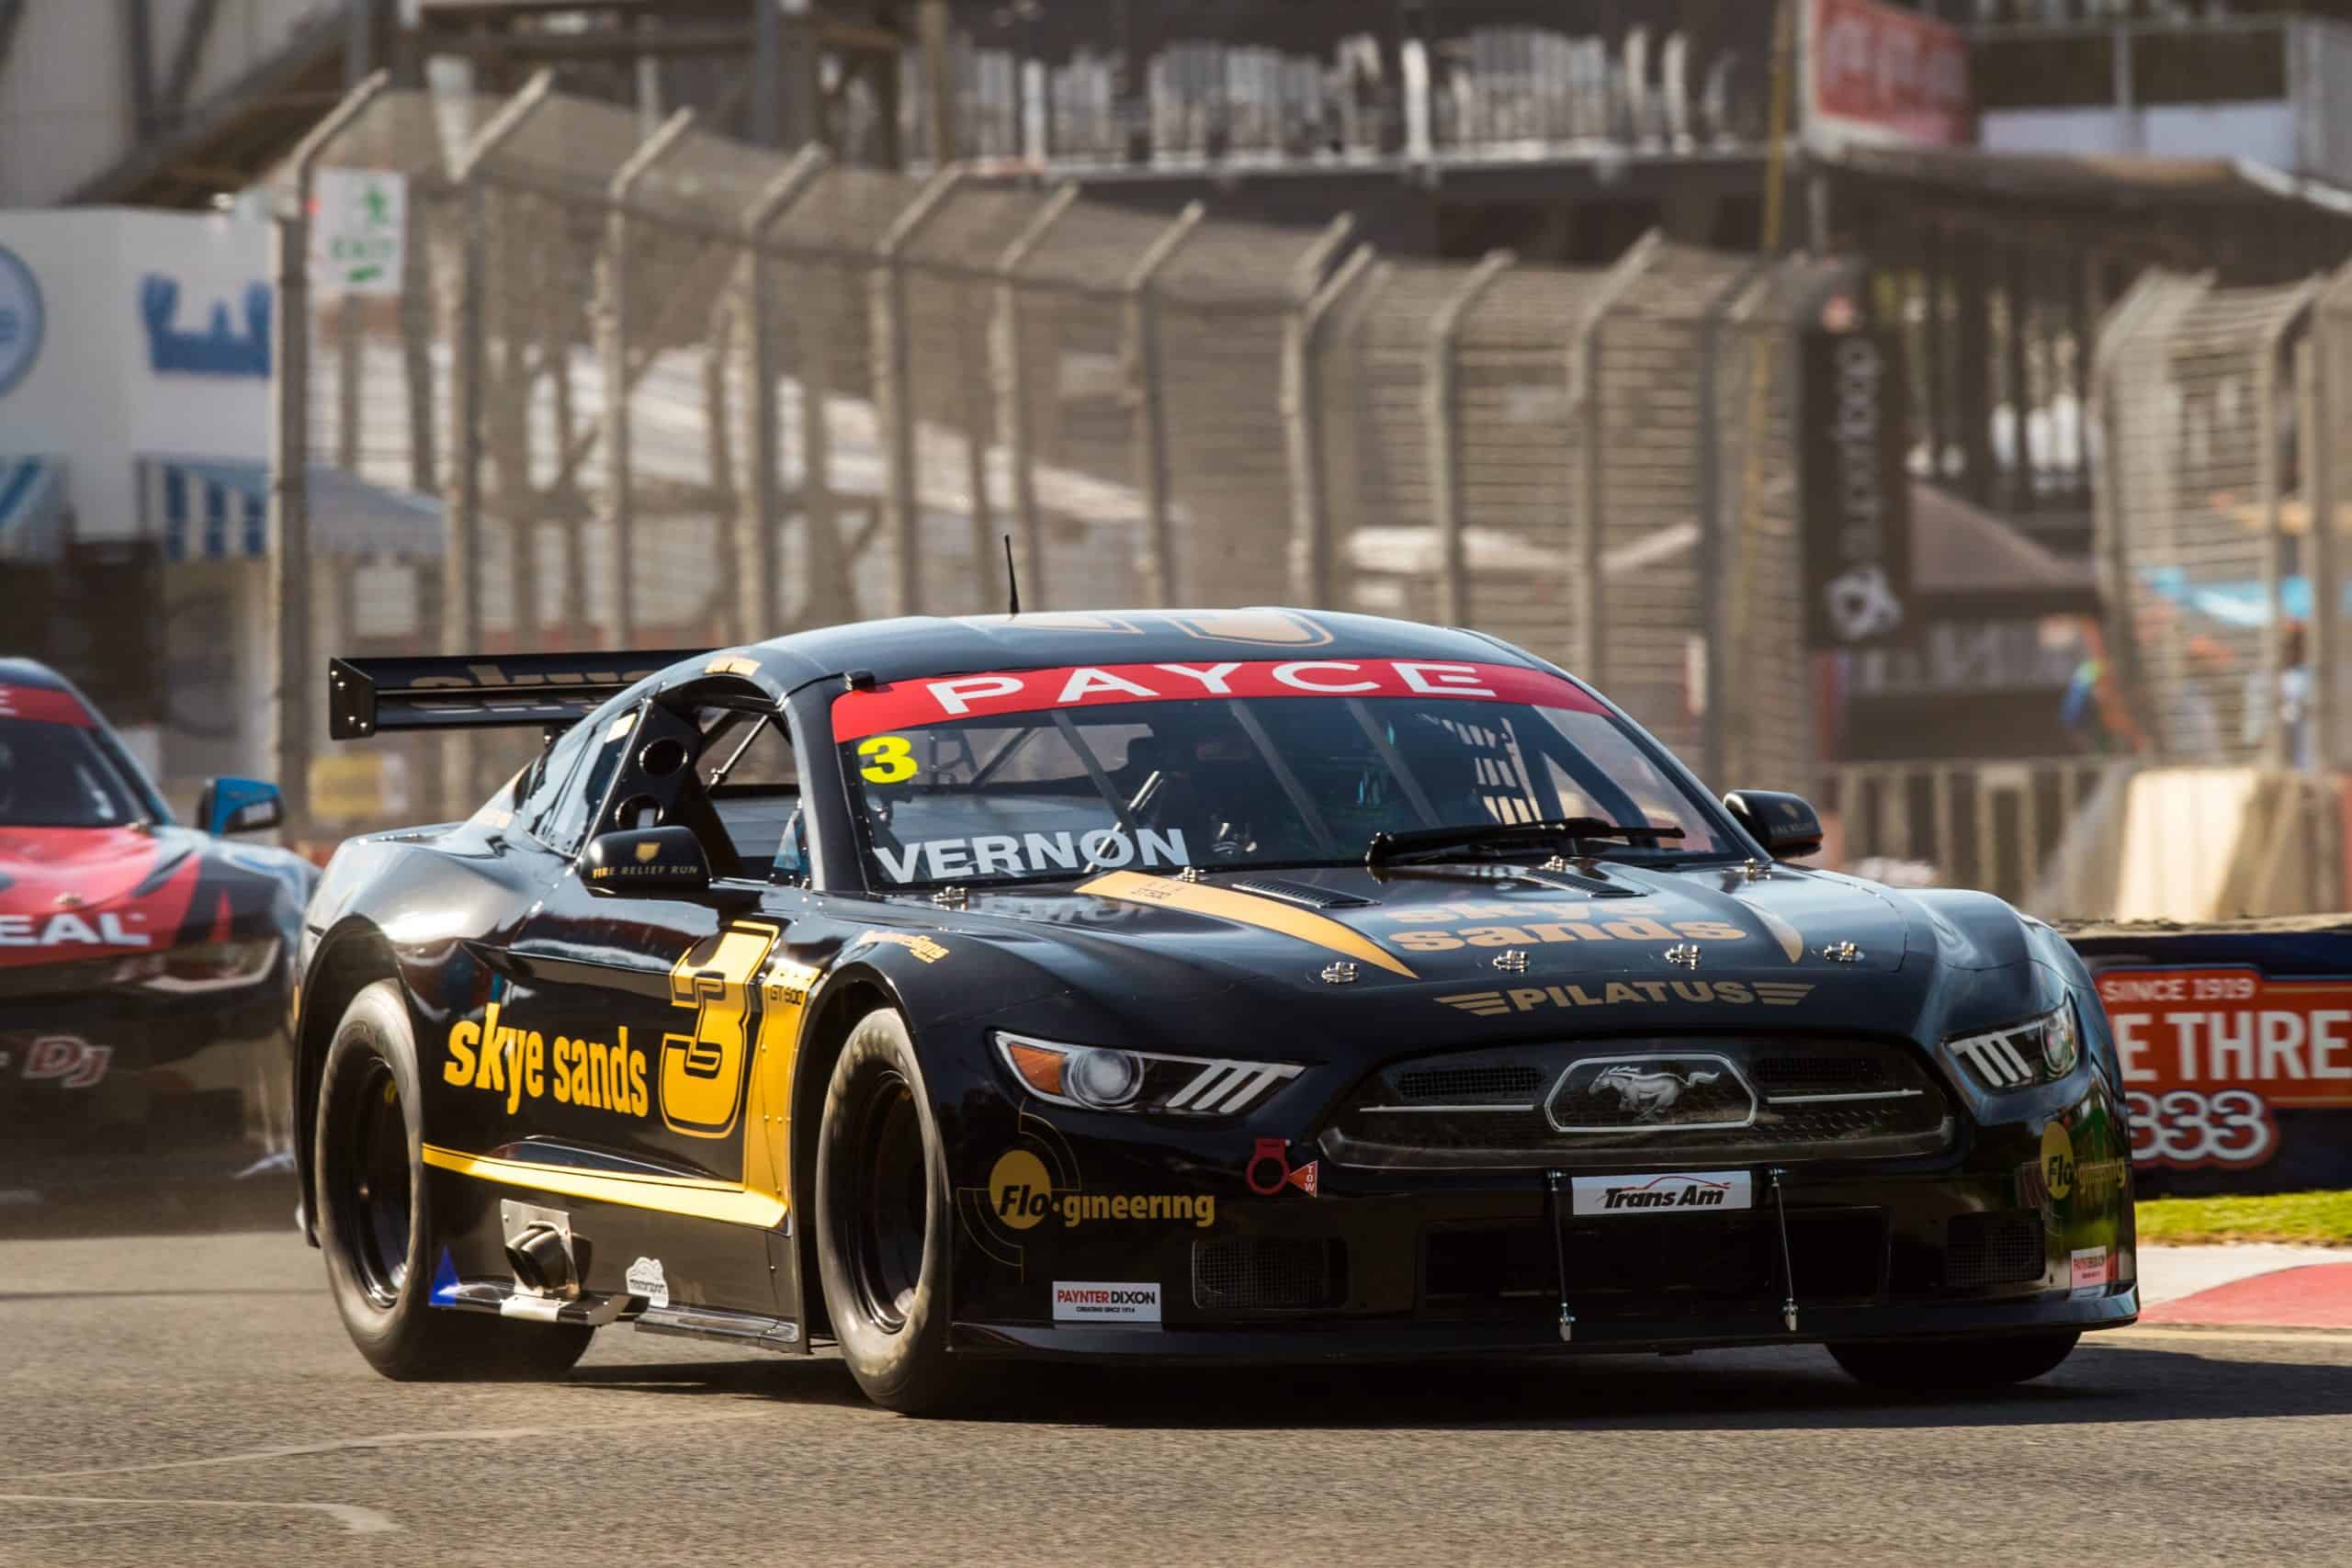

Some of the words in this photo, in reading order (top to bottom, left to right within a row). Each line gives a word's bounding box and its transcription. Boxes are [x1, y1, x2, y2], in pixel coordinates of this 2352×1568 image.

[926, 661, 1498, 714] PAYCE
[857, 736, 918, 784] 3
[874, 829, 1190, 883] VERNON
[1388, 916, 1747, 952] sands
[1506, 980, 1753, 1012] PILATUS
[2101, 978, 2188, 1002] SINCE
[659, 919, 779, 1139] 3
[443, 1002, 544, 1115] skye
[553, 1025, 649, 1118] sands
[1305, 1166, 1315, 1191] TOW
[1603, 1188, 1677, 1209] Trans
[1677, 1185, 1725, 1206] Am
